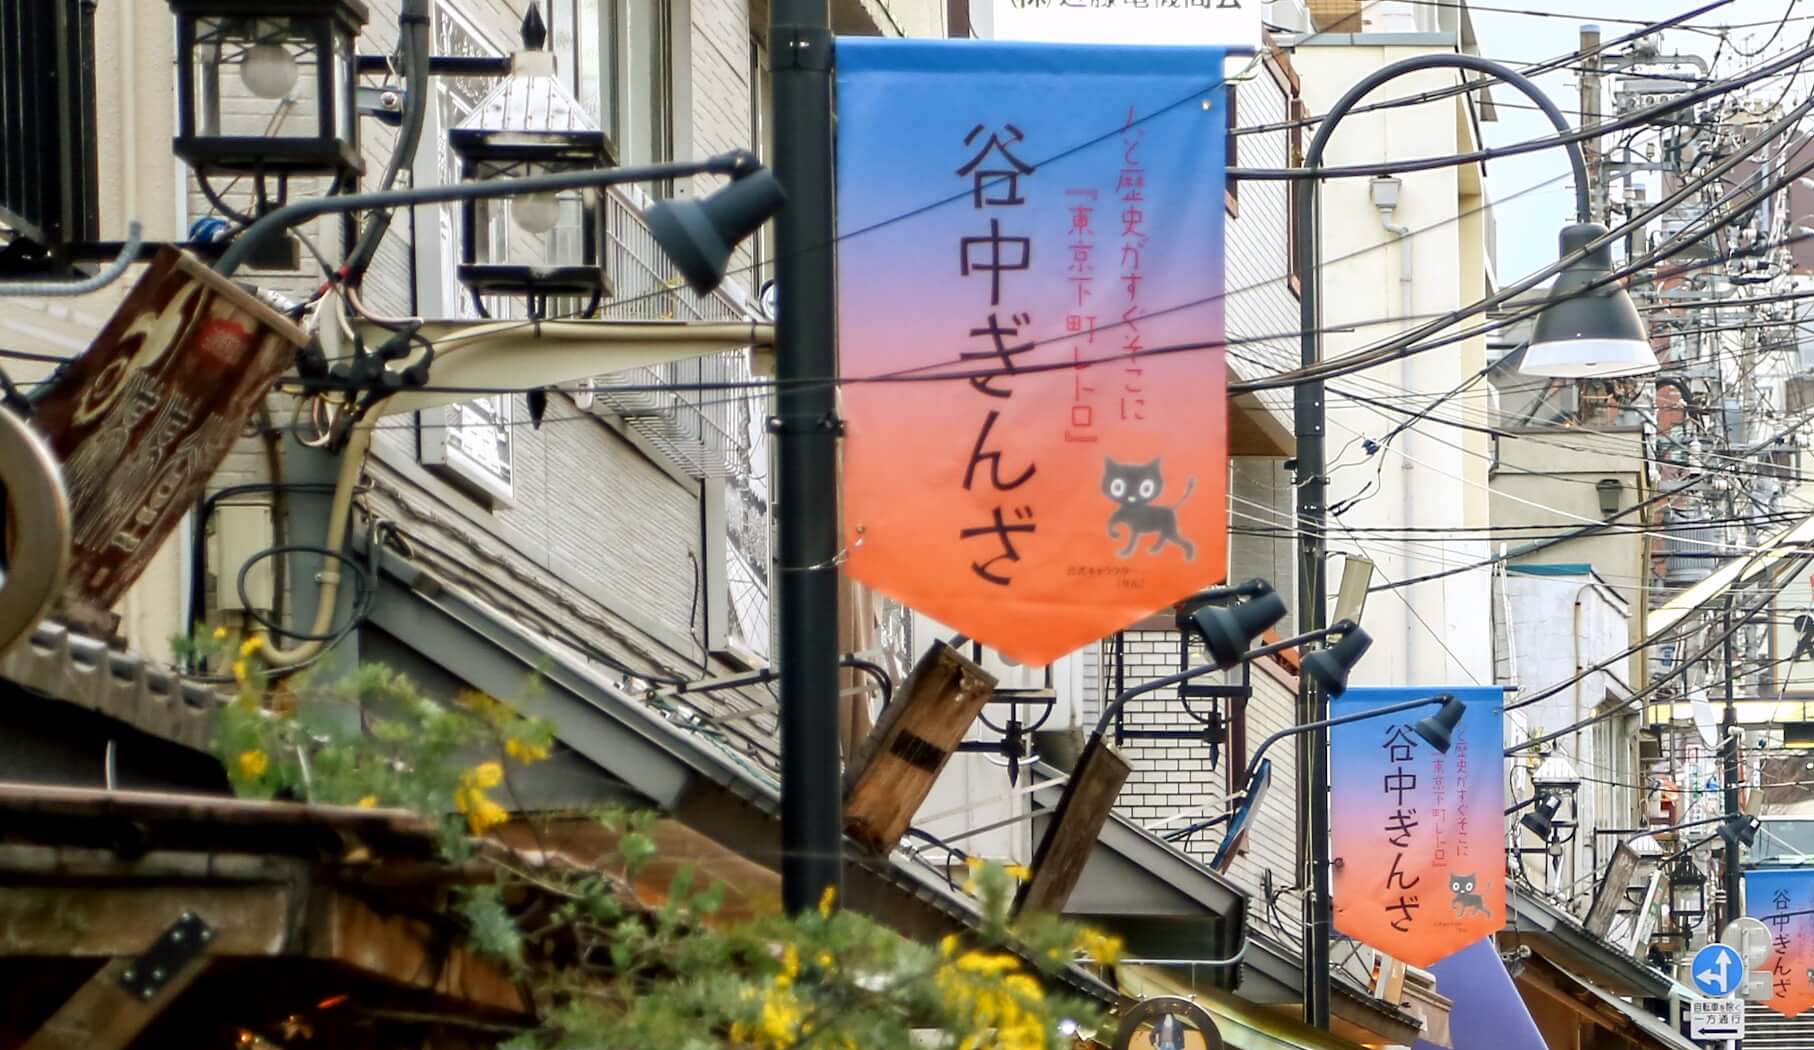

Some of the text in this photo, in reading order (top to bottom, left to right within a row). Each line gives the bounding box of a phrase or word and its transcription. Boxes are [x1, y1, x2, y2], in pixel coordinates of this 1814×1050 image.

[956, 122, 1039, 588] 谷中ぎんざ
[1115, 104, 1148, 423] 人と歴史がすぐそこに
[1382, 723, 1421, 933] 谷中ぎんざ
[1695, 1014, 1740, 1025] 一方通行
[1772, 888, 1792, 999] 谷中ぎんざ
